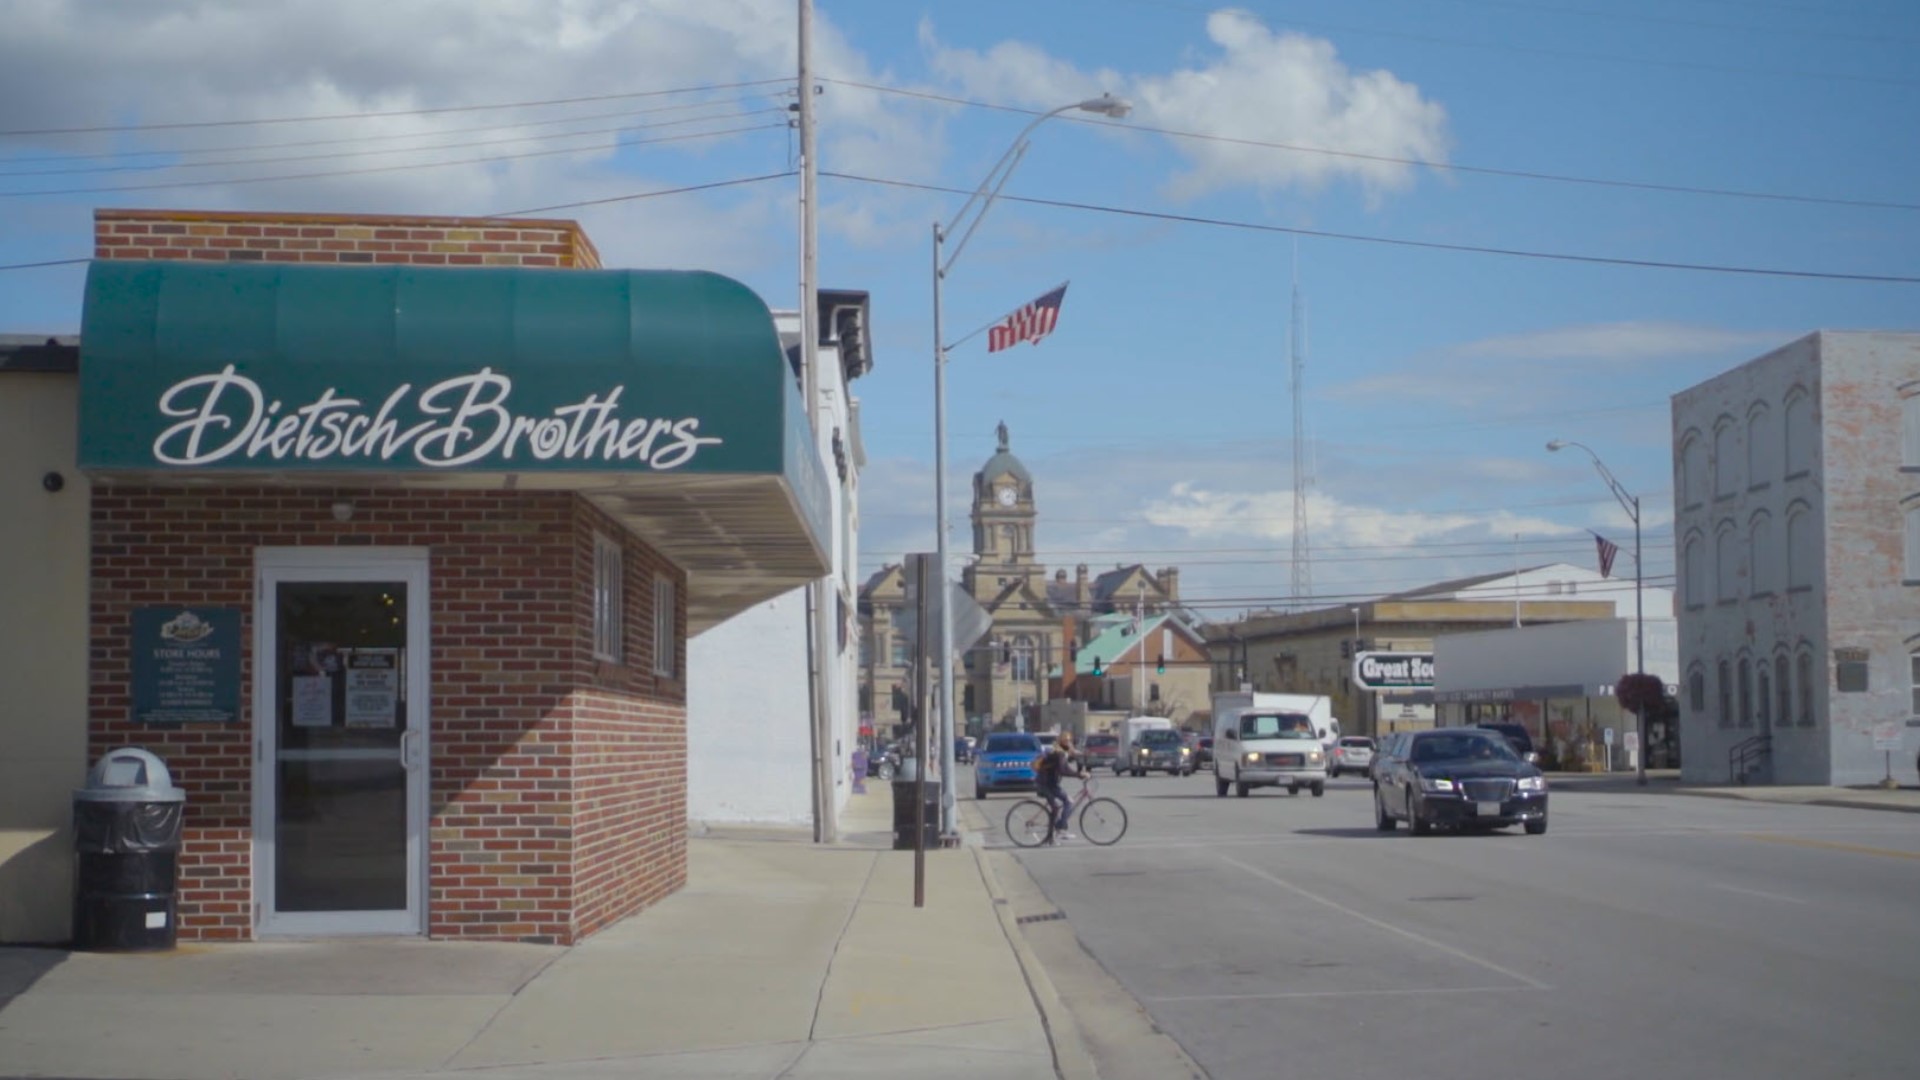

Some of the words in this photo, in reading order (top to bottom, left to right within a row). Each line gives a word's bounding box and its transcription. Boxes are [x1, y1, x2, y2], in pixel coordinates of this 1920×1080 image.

[152, 363, 428, 466] Dietsch
[413, 366, 723, 470] Brothers
[153, 648, 184, 659] STORE
[187, 648, 221, 659] HOURS
[1362, 657, 1409, 678] Great
